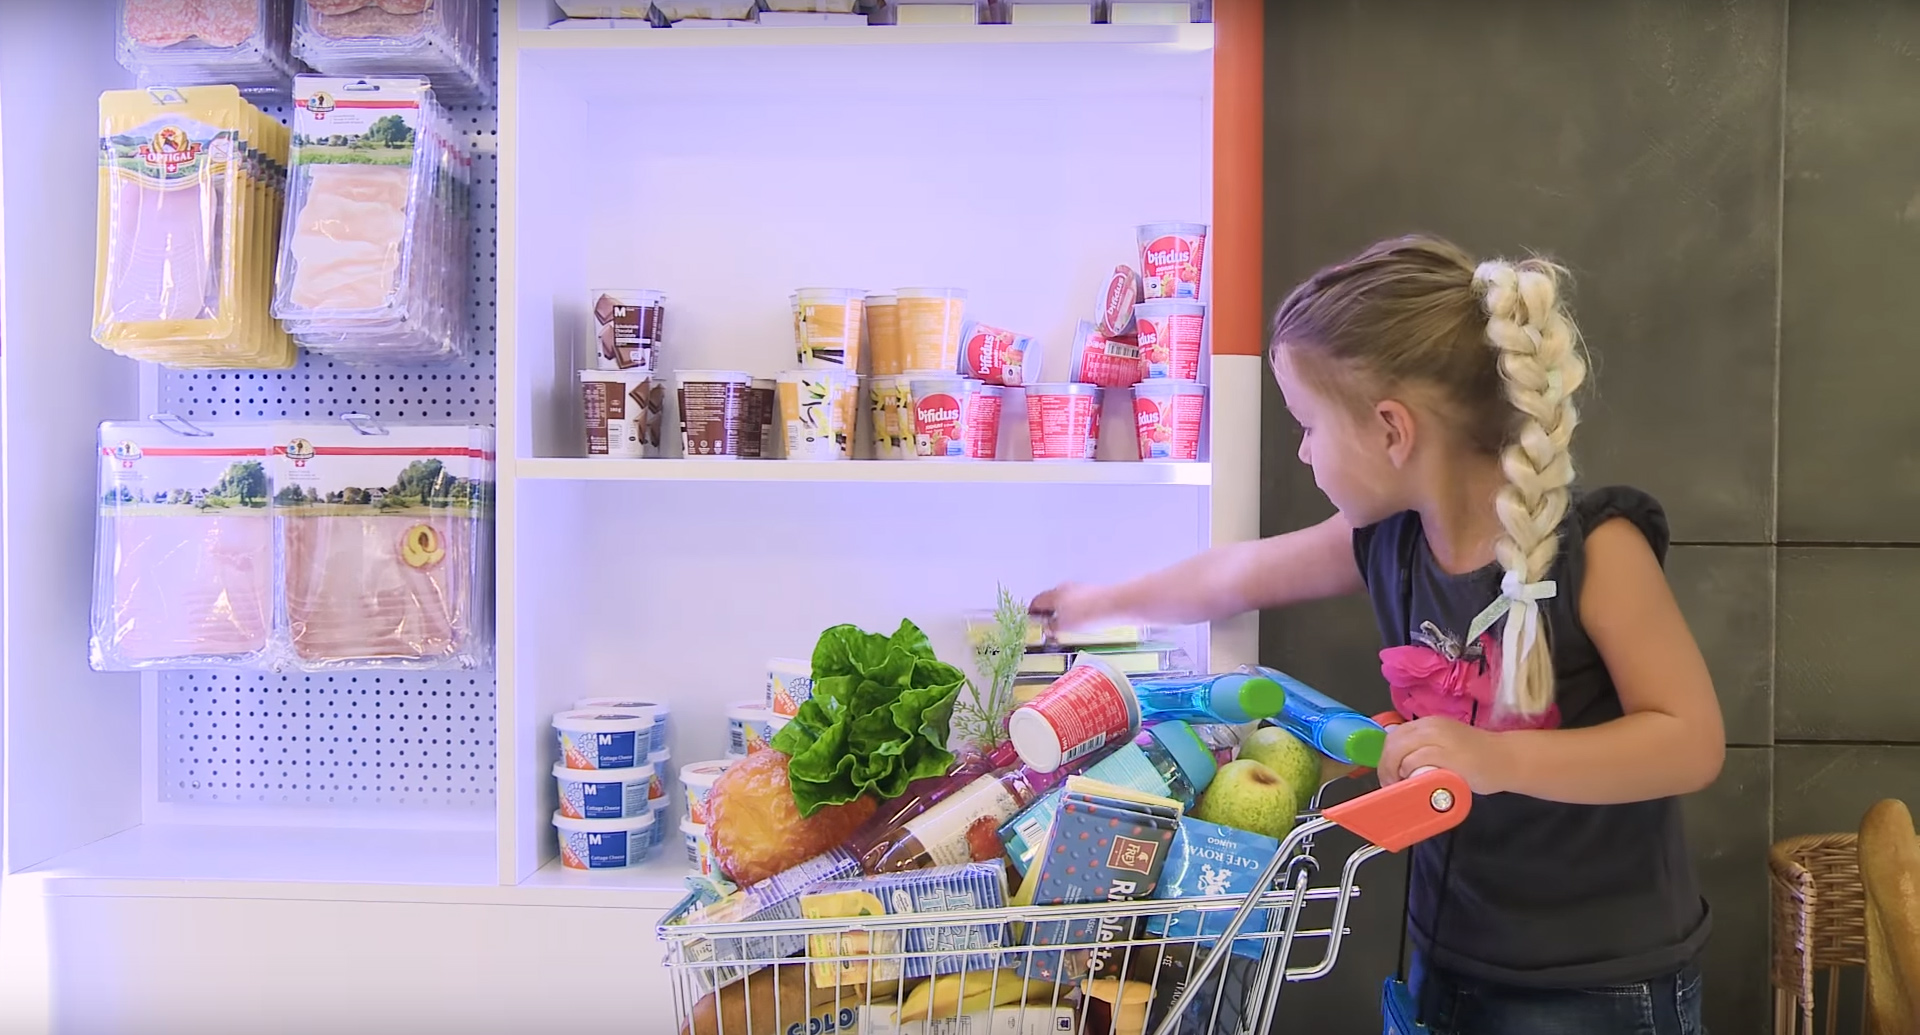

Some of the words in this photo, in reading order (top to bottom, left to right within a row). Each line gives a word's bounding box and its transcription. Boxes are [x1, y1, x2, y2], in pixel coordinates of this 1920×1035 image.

[147, 151, 193, 162] OPTIGAL
[1147, 249, 1190, 266] bifidus
[1107, 276, 1124, 315] bifidus
[614, 306, 626, 317] M
[978, 334, 995, 375] bifidus
[917, 407, 960, 423] bifidus
[598, 734, 612, 746] M
[584, 784, 597, 795] M
[588, 834, 602, 845] M
[1207, 837, 1237, 849] LUNGO
[1121, 843, 1141, 867] FREY
[1183, 845, 1224, 862] ROYA
[1226, 854, 1259, 870] CAFÉ
[1162, 955, 1173, 967] 33x
[786, 1007, 856, 1035] COLO
